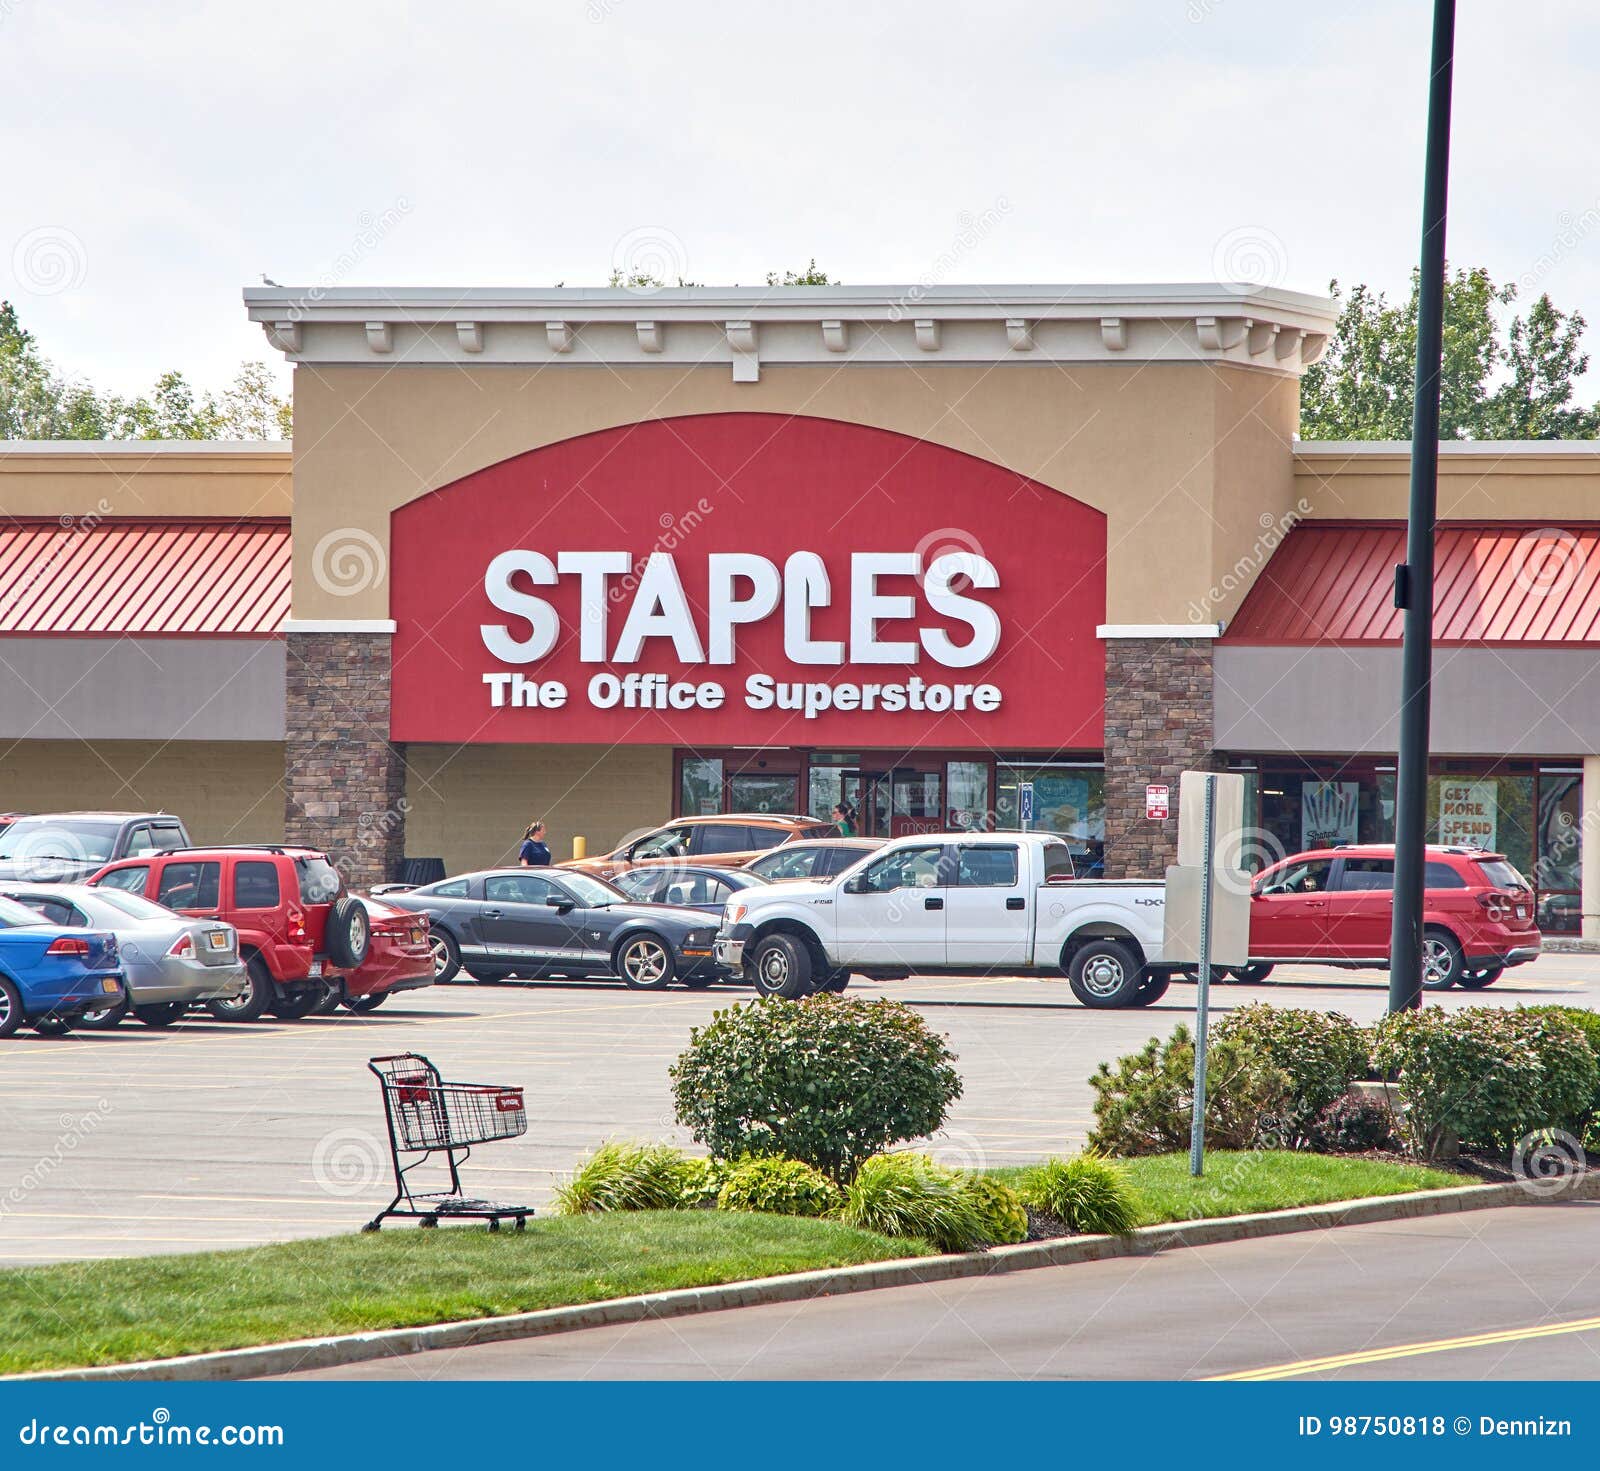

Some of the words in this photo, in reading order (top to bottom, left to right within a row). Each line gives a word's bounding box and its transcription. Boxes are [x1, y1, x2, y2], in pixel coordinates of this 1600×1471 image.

[480, 550, 1001, 668] STAPLES
[482, 672, 567, 709] The
[587, 672, 725, 711] Office
[744, 673, 1002, 719] Superstore
[1444, 788, 1471, 800] GET
[1443, 821, 1493, 835] SPEND
